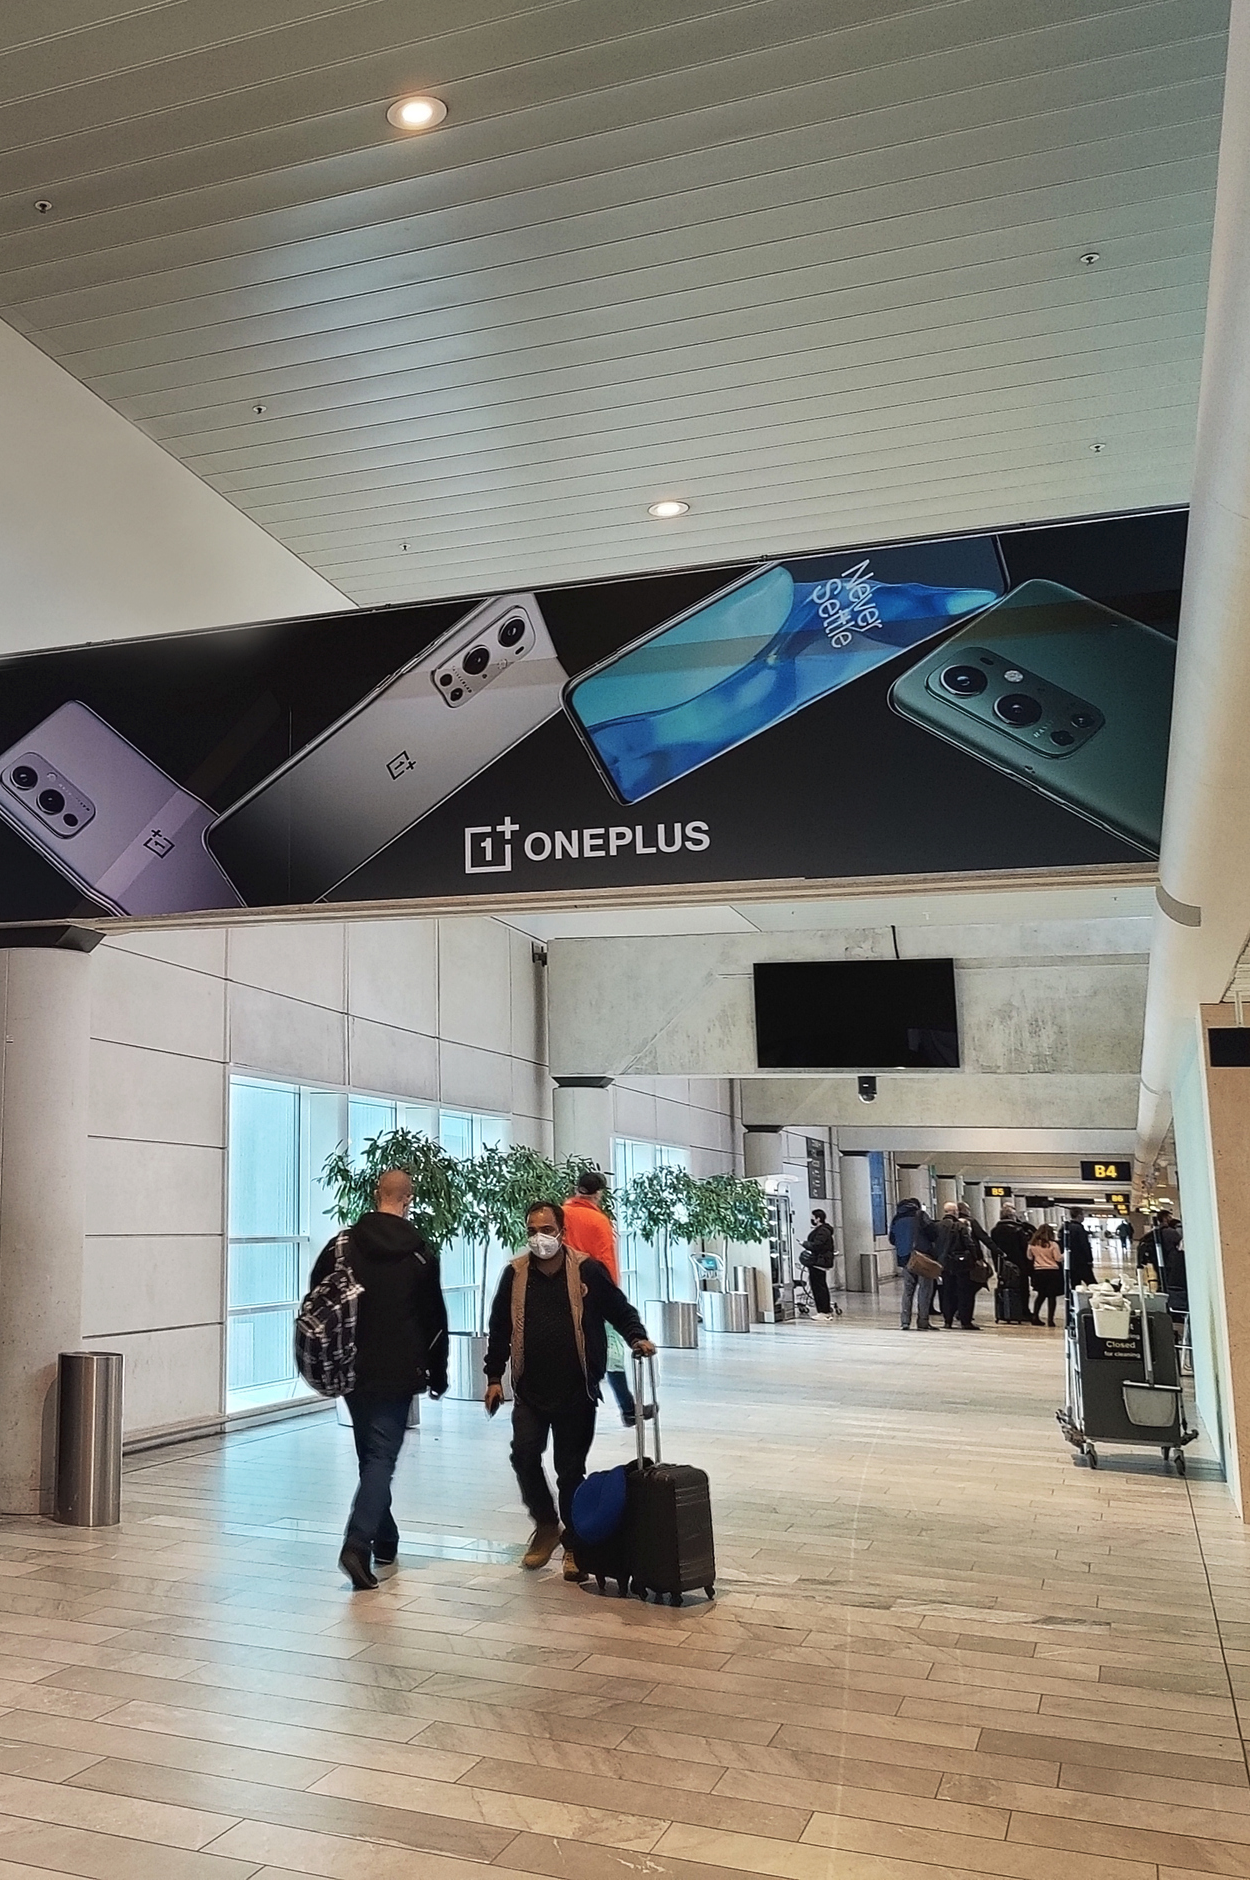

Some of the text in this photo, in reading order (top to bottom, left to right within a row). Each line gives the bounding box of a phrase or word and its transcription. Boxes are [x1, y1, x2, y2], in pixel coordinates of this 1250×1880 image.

[812, 578, 855, 648] Settle
[841, 559, 883, 632] Never
[524, 821, 711, 861] ONEPLUS
[1094, 1164, 1117, 1178] B4
[1106, 1340, 1136, 1348] Closed
